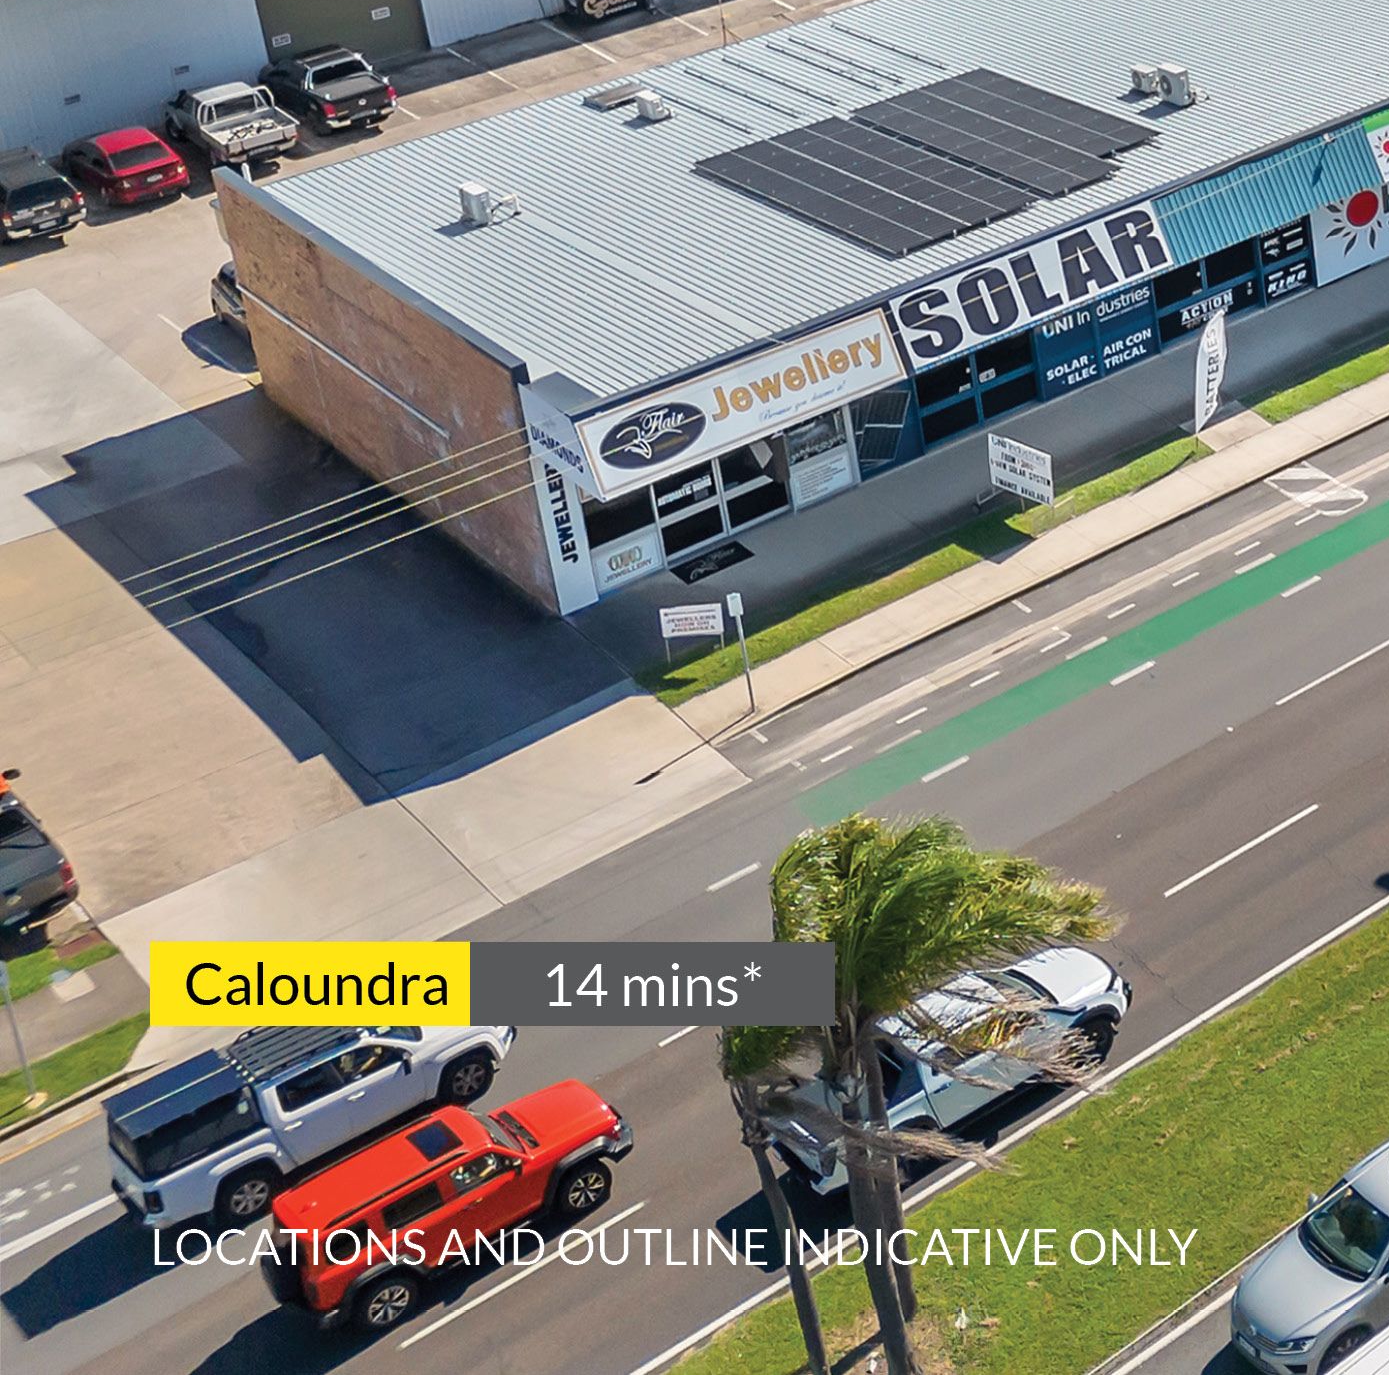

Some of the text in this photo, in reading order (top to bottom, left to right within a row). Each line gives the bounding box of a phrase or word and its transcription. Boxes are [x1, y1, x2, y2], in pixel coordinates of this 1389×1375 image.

[899, 209, 1168, 359] SOLAR
[1181, 291, 1233, 323] ACTION
[1042, 312, 1074, 339] UNI
[712, 333, 882, 422] Jewellery
[1046, 328, 1152, 382] SOLAR AIR CON
[1204, 328, 1218, 418] BATTERIES
[530, 424, 585, 473] DIAMONDS
[544, 463, 578, 564] JEWELLER
[604, 557, 653, 583] JEWELLERY
